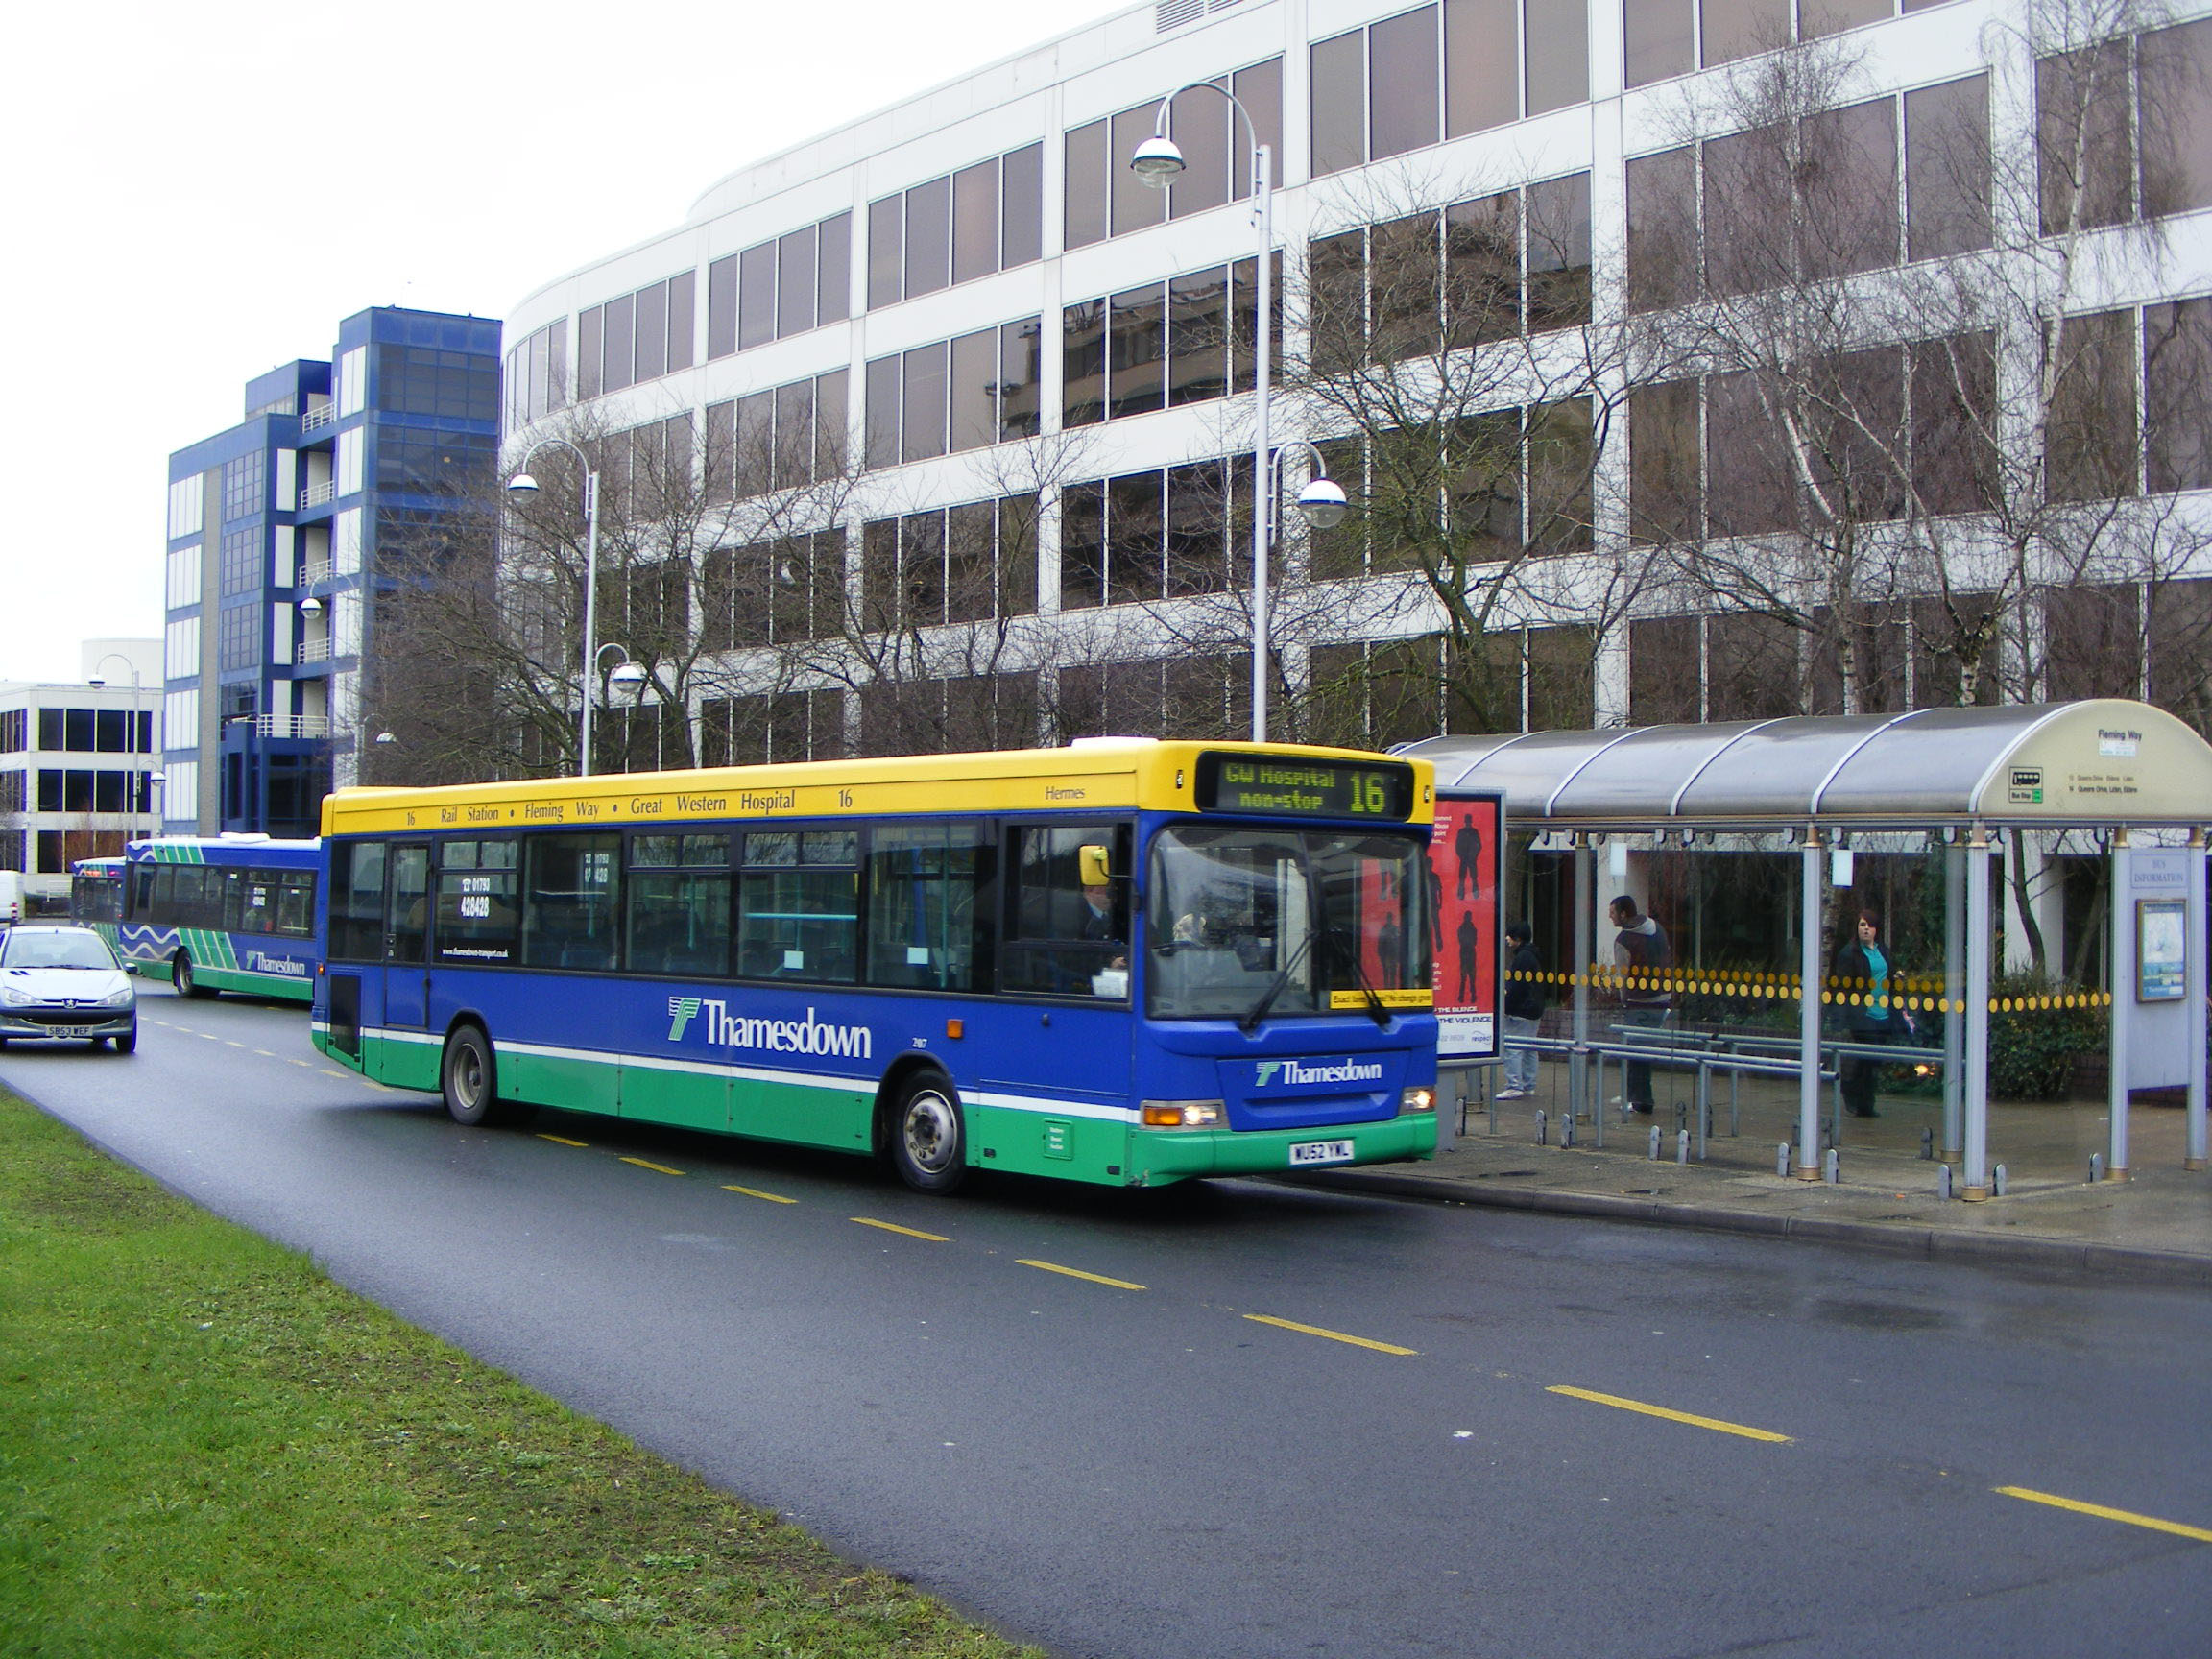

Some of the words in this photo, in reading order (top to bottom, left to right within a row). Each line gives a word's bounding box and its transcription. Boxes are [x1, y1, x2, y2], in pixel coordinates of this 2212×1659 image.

[2098, 728, 2126, 741] Fleming
[2128, 729, 2143, 742] Way
[1224, 765, 1255, 783] GW
[1259, 765, 1336, 788] Hospital
[1045, 785, 1085, 800] Hermes
[1239, 790, 1323, 809] non-stop
[1349, 771, 1385, 813] 16
[407, 811, 416, 826] 16
[441, 807, 457, 823] Rail
[468, 805, 499, 822] Station
[524, 803, 564, 823] Fleming
[575, 801, 599, 821] Way
[631, 797, 663, 815] Great
[677, 795, 727, 812] Western
[741, 789, 796, 815] Hospital
[838, 788, 854, 808] 16
[2134, 873, 2183, 884] INFORMATION
[461, 895, 490, 917] 428428
[256, 951, 305, 976] Thamesdown
[704, 998, 872, 1060] Thamesdown
[1455, 1015, 1492, 1024] VIOLENCE
[49, 1026, 71, 1036] SB53
[1281, 1057, 1382, 1085] Thamesdown
